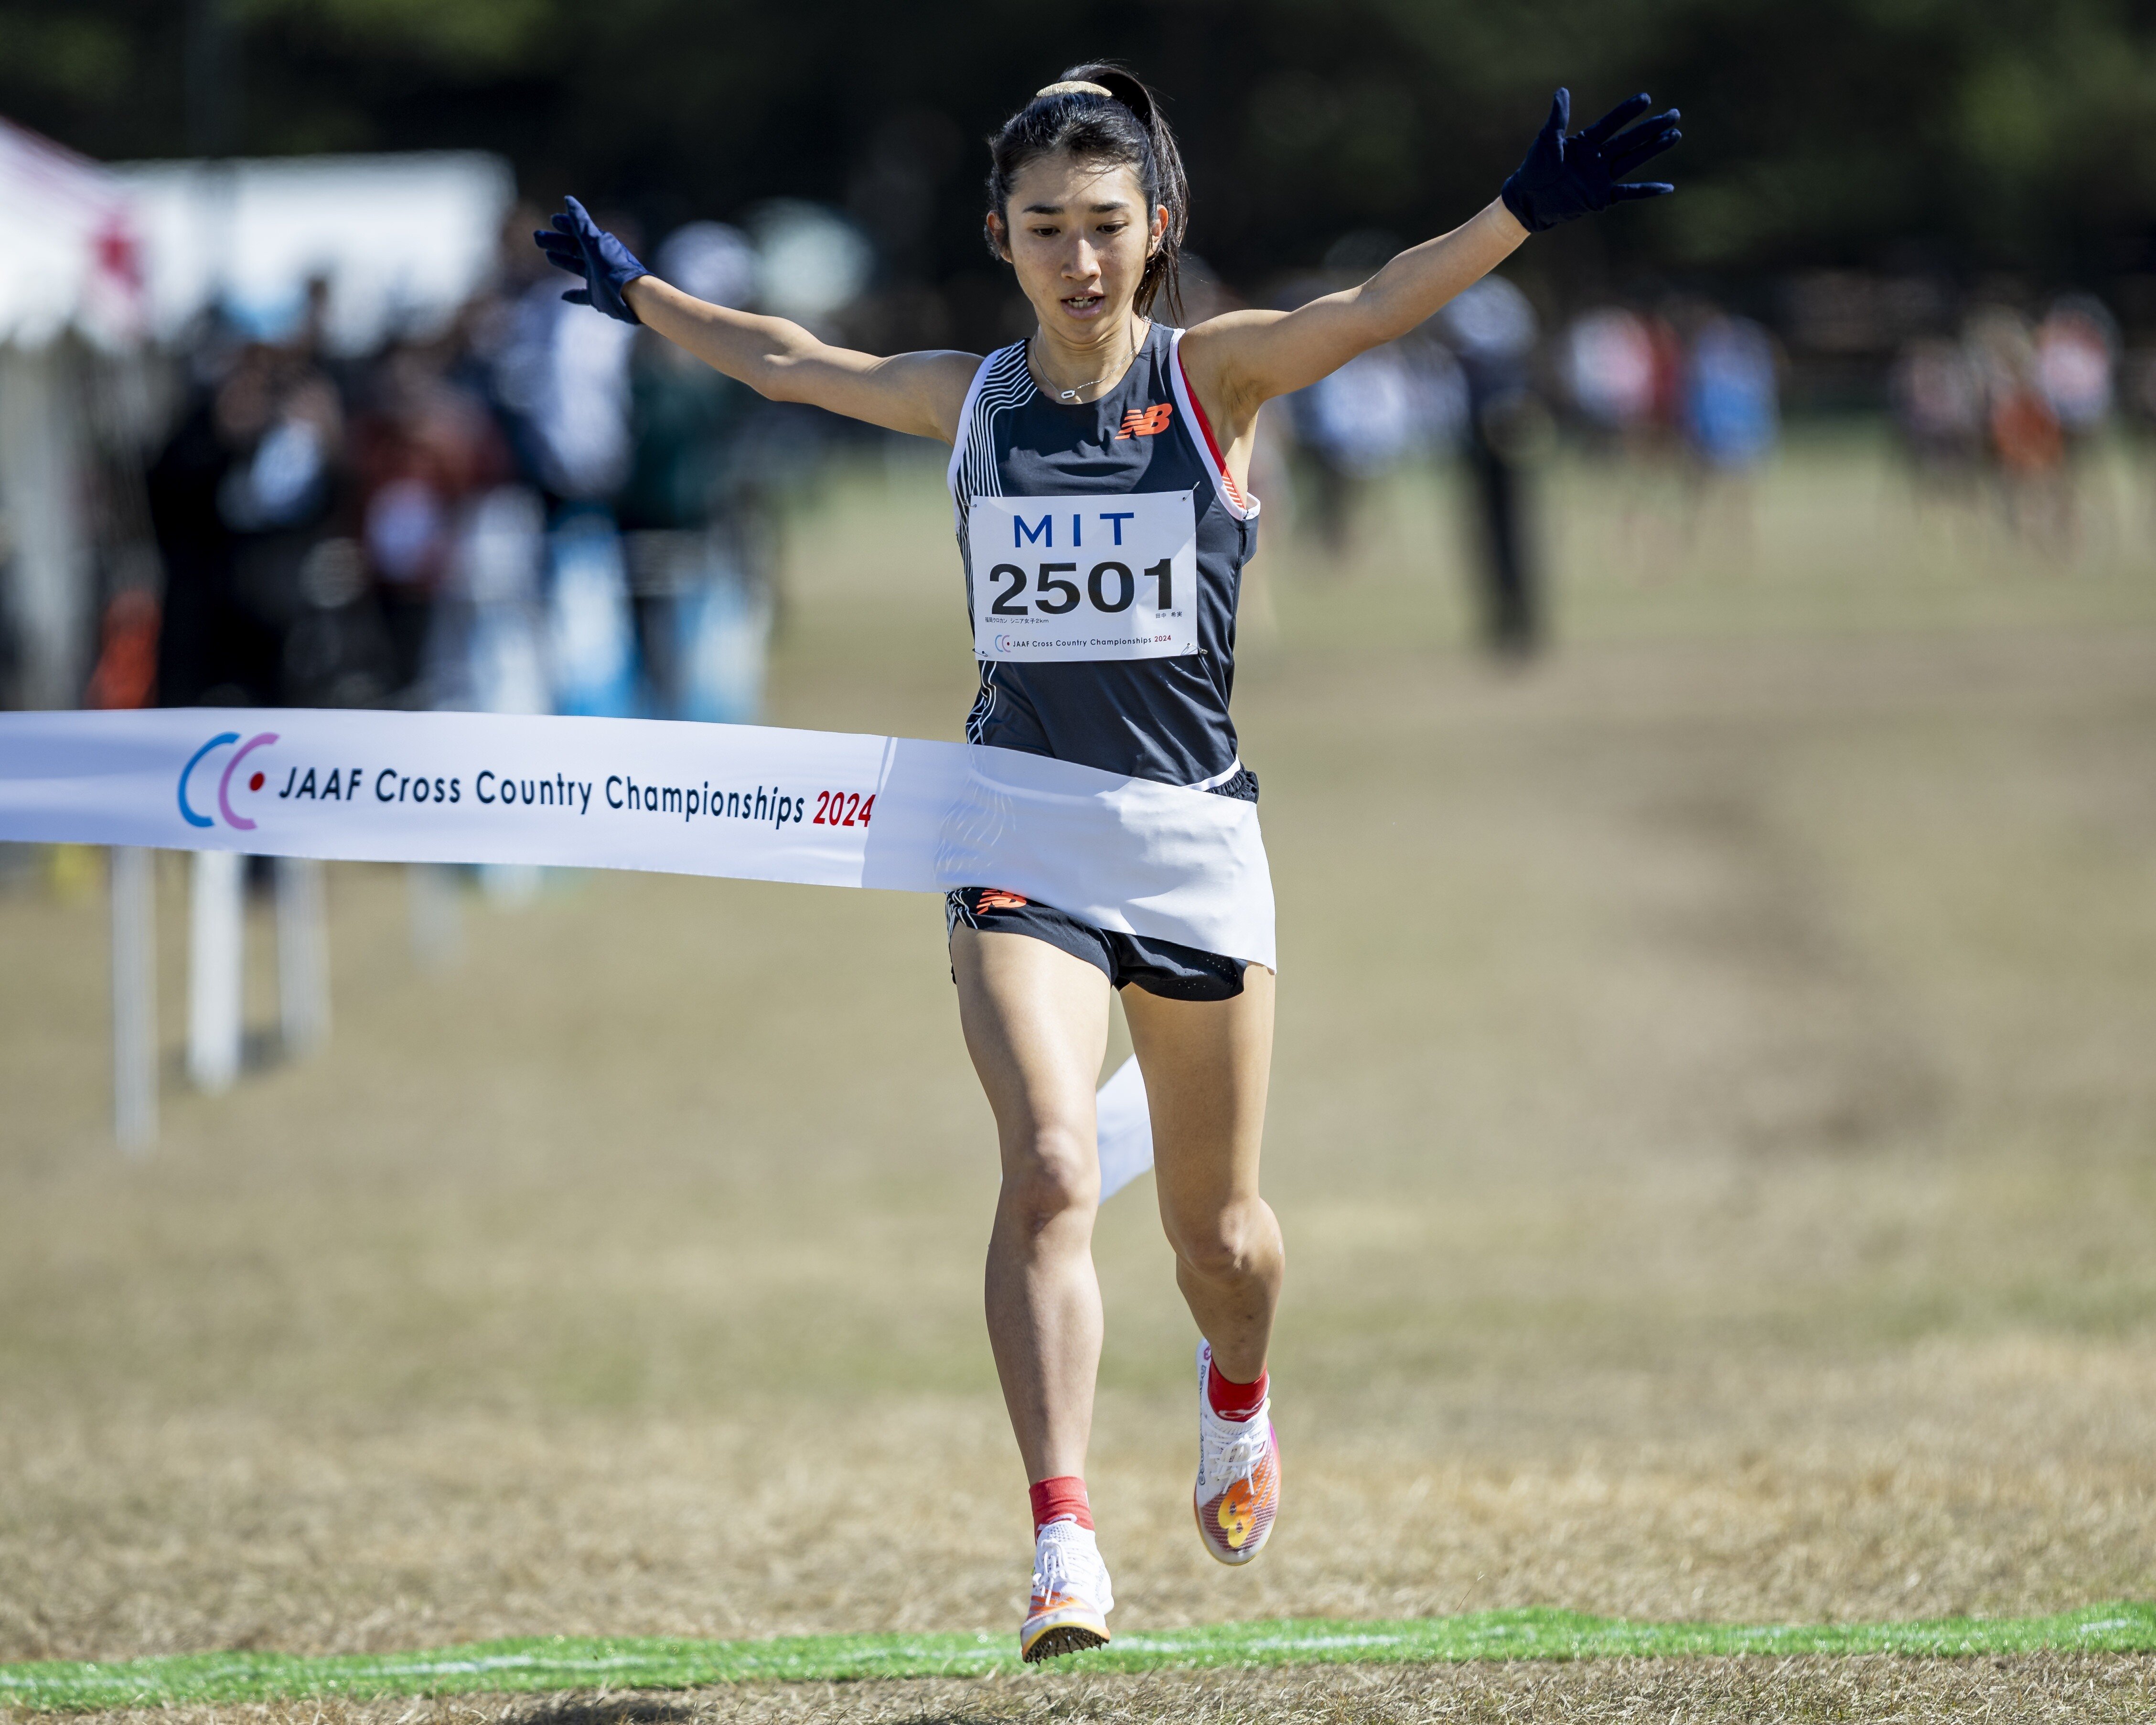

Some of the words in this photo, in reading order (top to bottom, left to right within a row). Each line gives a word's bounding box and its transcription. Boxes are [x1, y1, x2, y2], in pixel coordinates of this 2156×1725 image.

[1013, 512, 1135, 548] MIT
[989, 558, 1172, 615] 2501
[1055, 639, 1087, 647] Country
[1090, 637, 1151, 647] Championships
[1154, 635, 1171, 643] 2024
[279, 766, 363, 801] JAAF
[375, 768, 461, 803] Cross
[476, 770, 592, 815] Country
[606, 775, 804, 830] Championships
[812, 790, 876, 828] 2024
